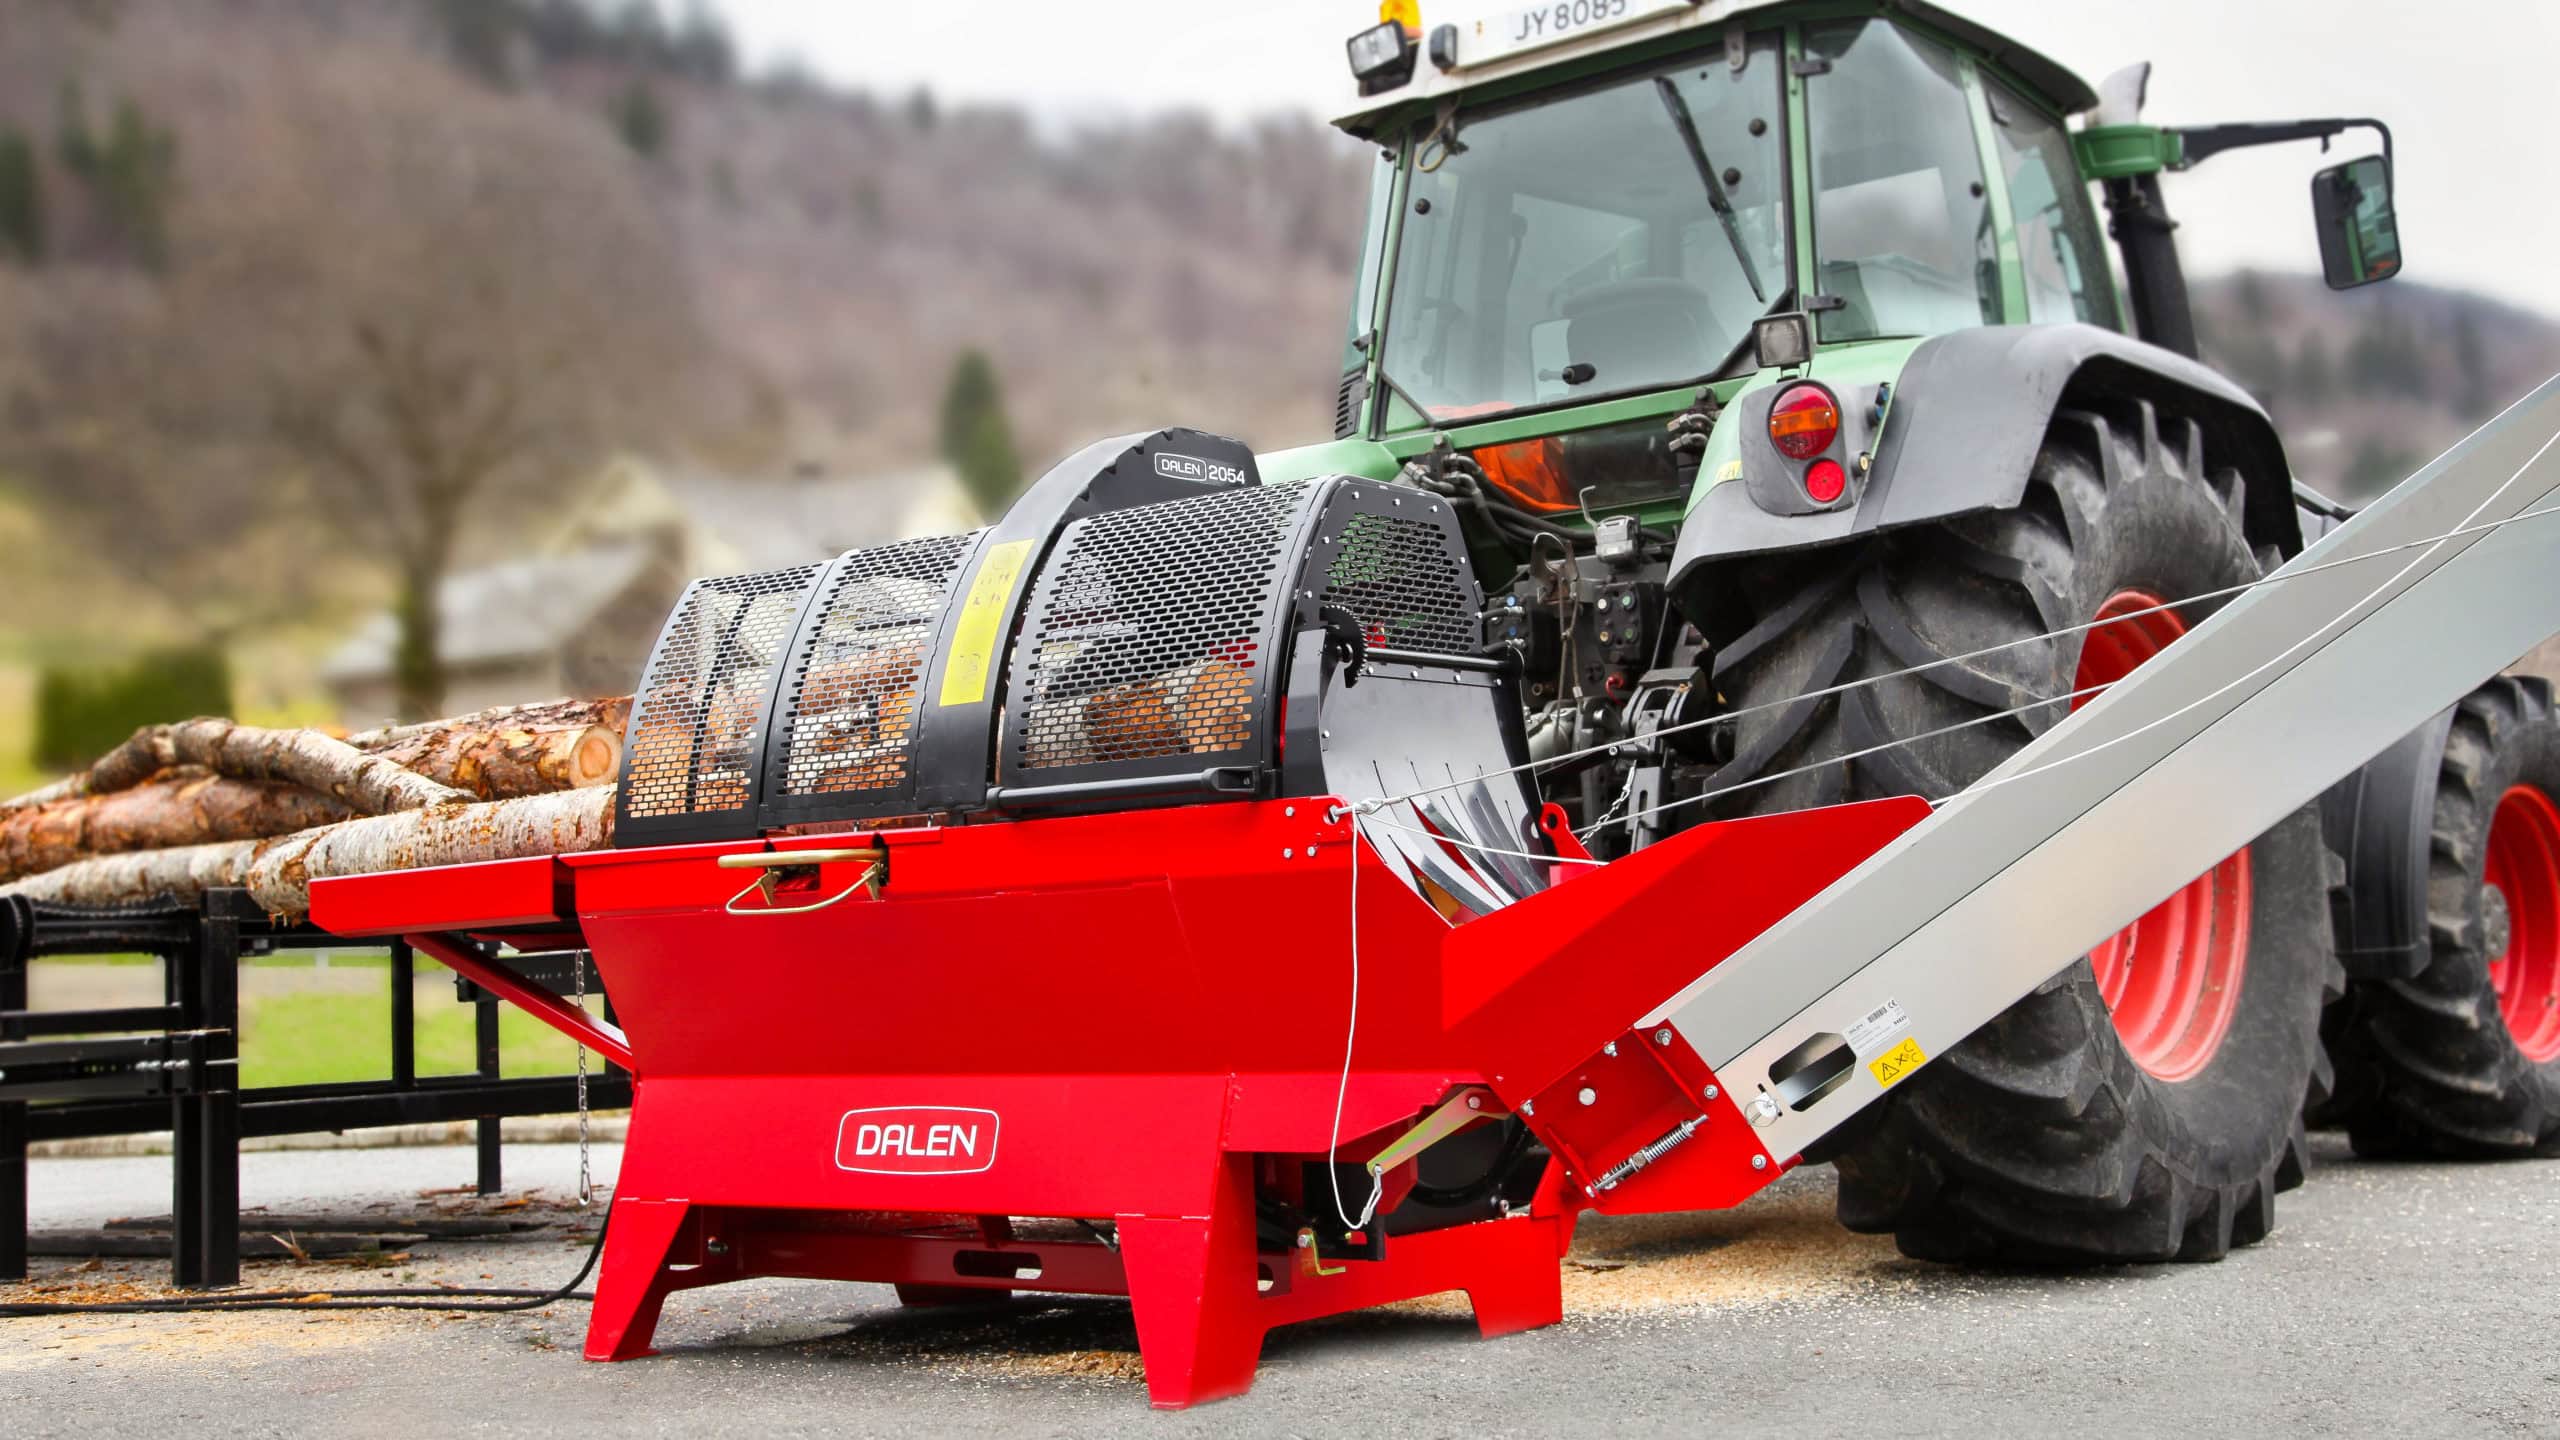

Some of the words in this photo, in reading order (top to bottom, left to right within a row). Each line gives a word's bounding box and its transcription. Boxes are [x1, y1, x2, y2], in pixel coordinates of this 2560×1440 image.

[1515, 8, 1548, 41] JY
[1161, 458, 1201, 476] DALEN
[1208, 464, 1246, 485] 2054
[855, 1124, 978, 1157] DALEN
